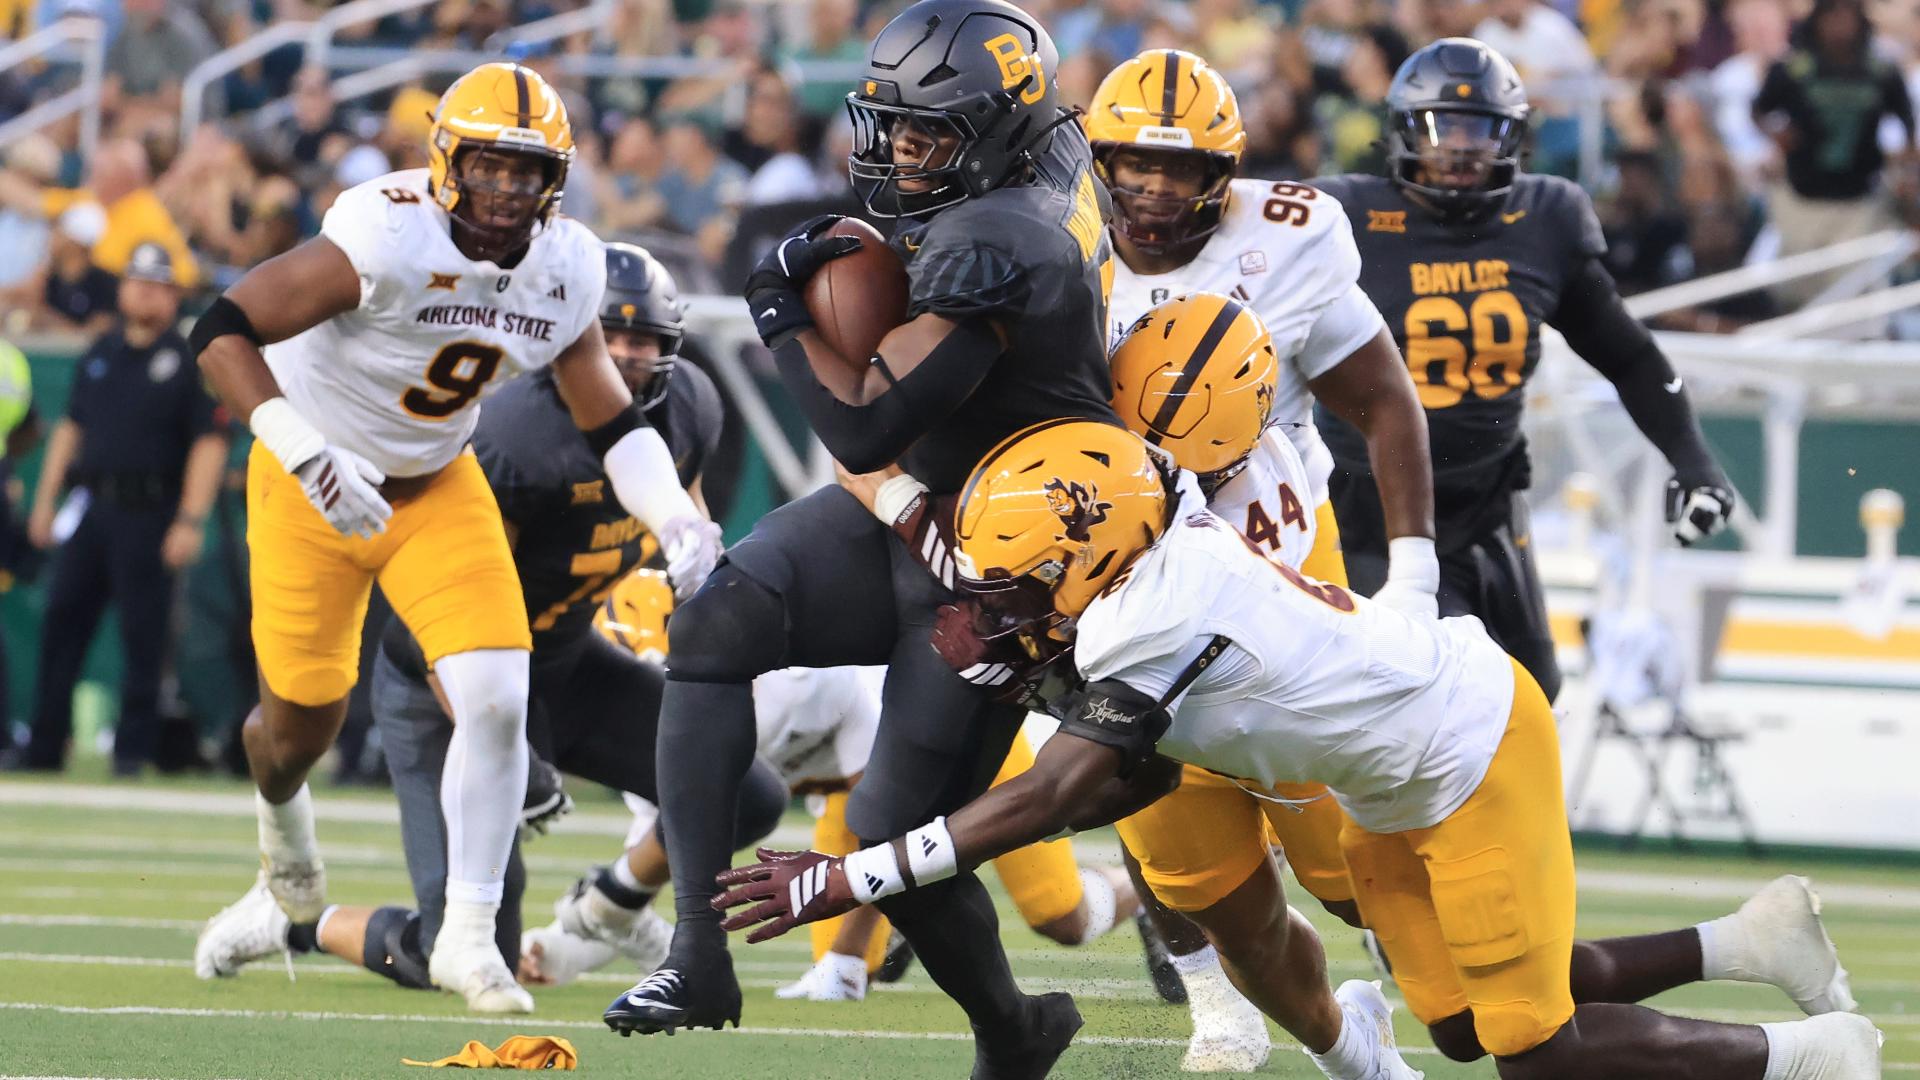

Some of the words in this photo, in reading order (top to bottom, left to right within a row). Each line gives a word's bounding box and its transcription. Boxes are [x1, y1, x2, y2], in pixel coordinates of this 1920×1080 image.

[1263, 182, 1317, 228] 99
[1409, 259, 1510, 295] BAYLOR
[416, 305, 496, 329] ARIZONA
[504, 312, 557, 342] STATE
[1404, 290, 1529, 409] 68
[400, 340, 505, 422] 9
[1246, 482, 1308, 551] 44
